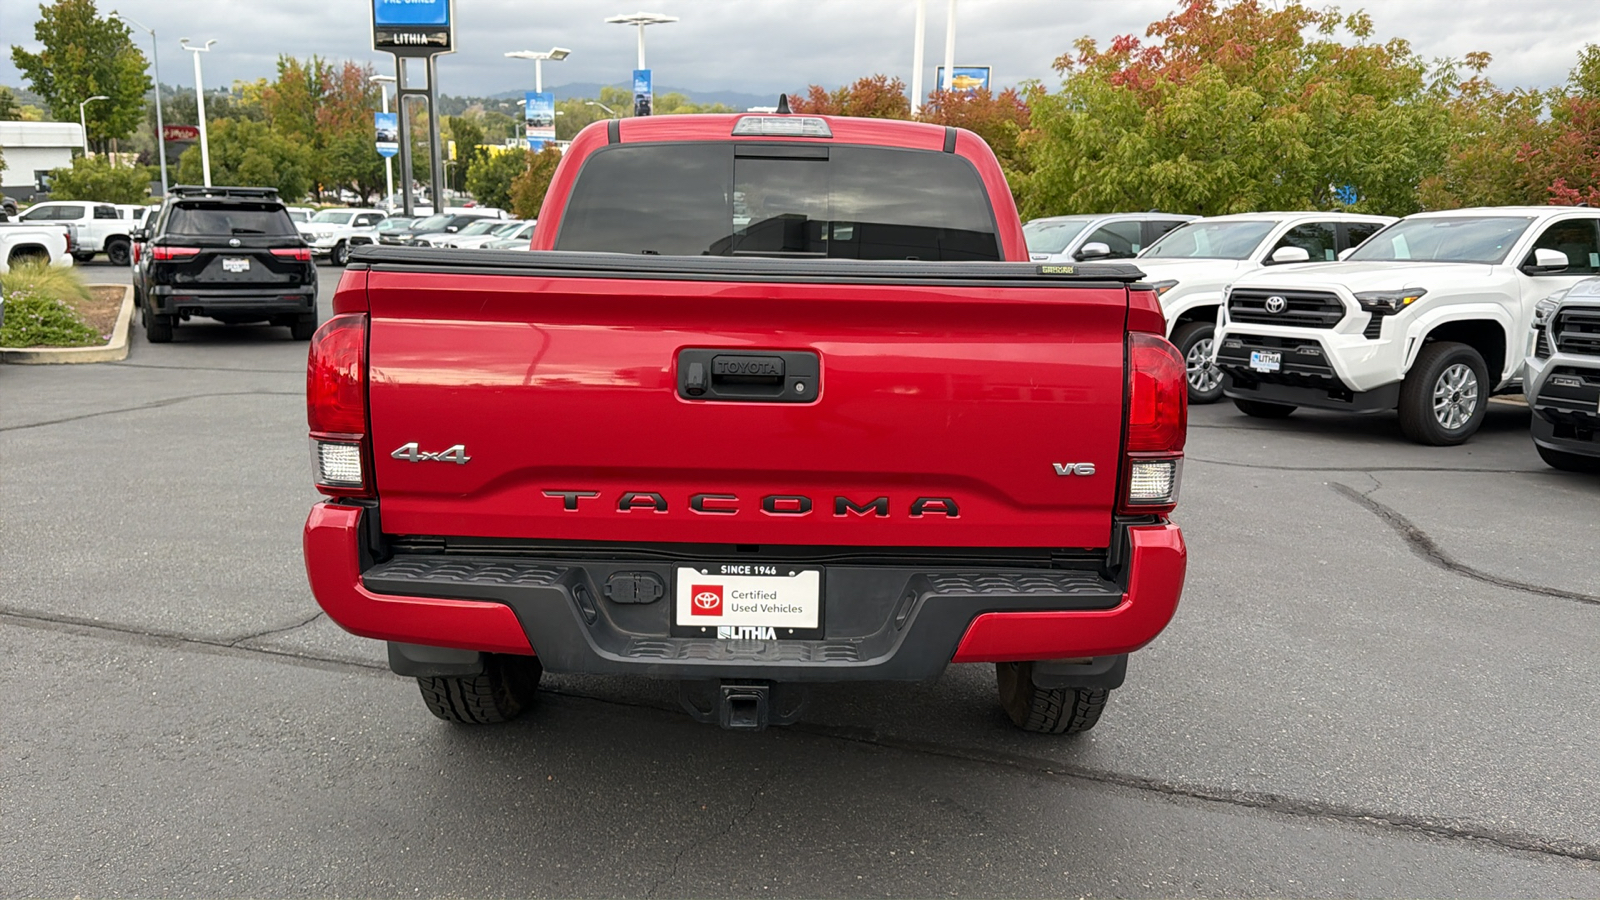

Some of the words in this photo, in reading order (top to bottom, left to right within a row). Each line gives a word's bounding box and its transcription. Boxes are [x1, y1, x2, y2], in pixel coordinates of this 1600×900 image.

[393, 33, 428, 45] LITHIA
[1258, 354, 1280, 364] LITHIA
[718, 362, 778, 375] TOYOTA
[1052, 462, 1096, 476] V6
[541, 490, 961, 519] TACOMA
[720, 564, 751, 575] SINCE
[753, 566, 777, 575] 1946
[731, 590, 777, 600] Certified
[731, 603, 758, 613] Used
[761, 604, 803, 614] Vehicles
[731, 626, 777, 640] LITHIA
